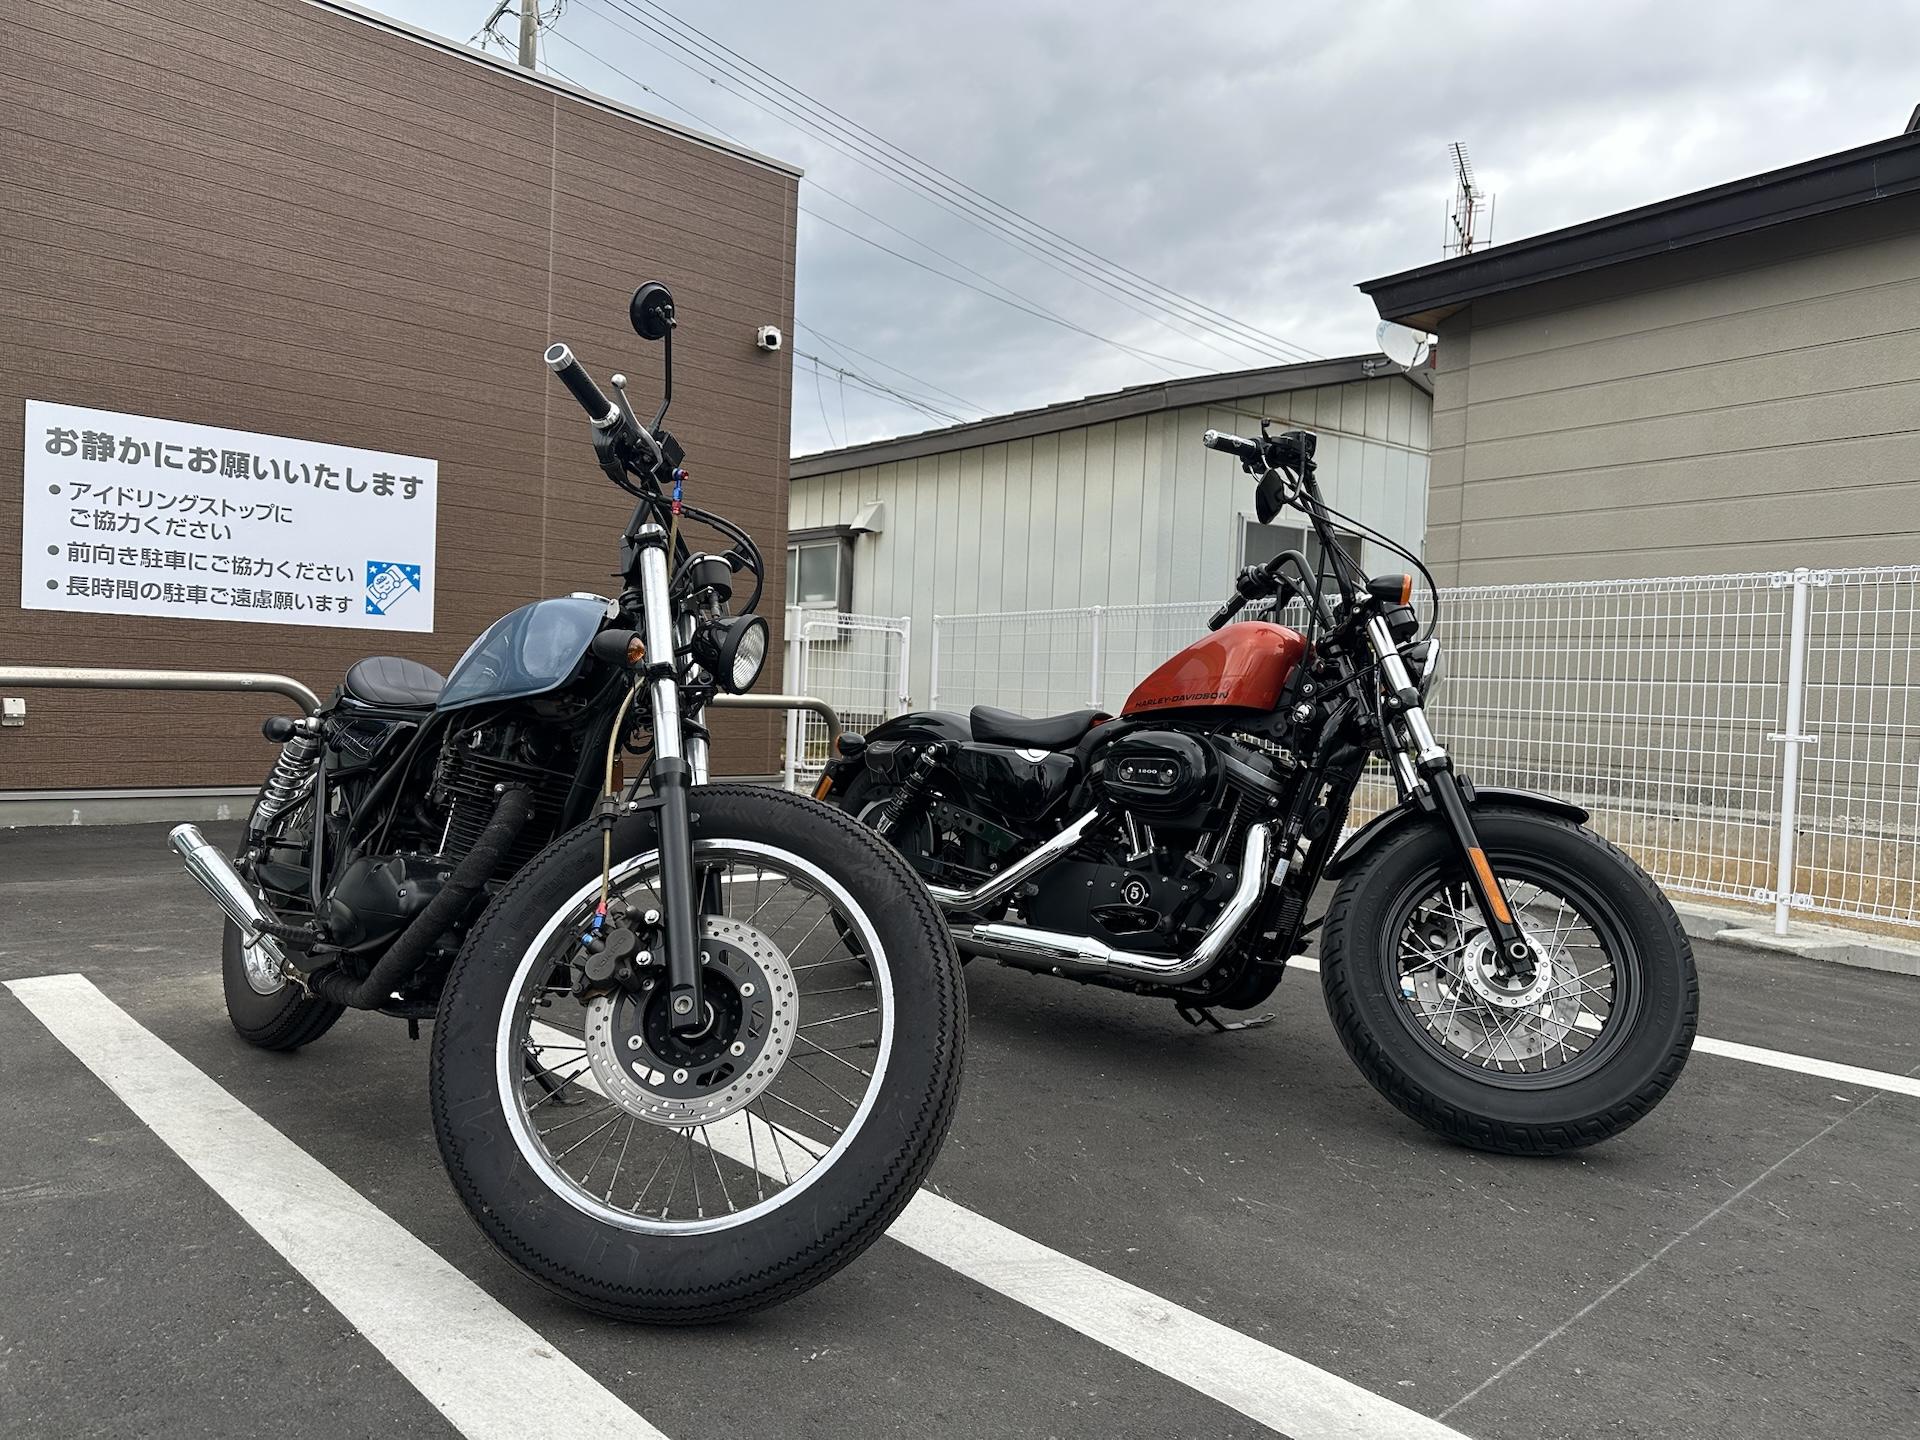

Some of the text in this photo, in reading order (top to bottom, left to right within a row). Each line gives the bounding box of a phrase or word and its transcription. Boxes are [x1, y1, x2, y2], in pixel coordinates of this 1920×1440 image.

[45, 427, 424, 500] お静かにお願いいたします
[69, 481, 293, 524] アイドリングストップに
[69, 508, 232, 541] ご協力ください
[67, 542, 355, 583] 前向き駐車にご協力ください
[66, 575, 353, 614] 長時間の駐車ご遠慮願います
[1129, 886, 1140, 900] 5
